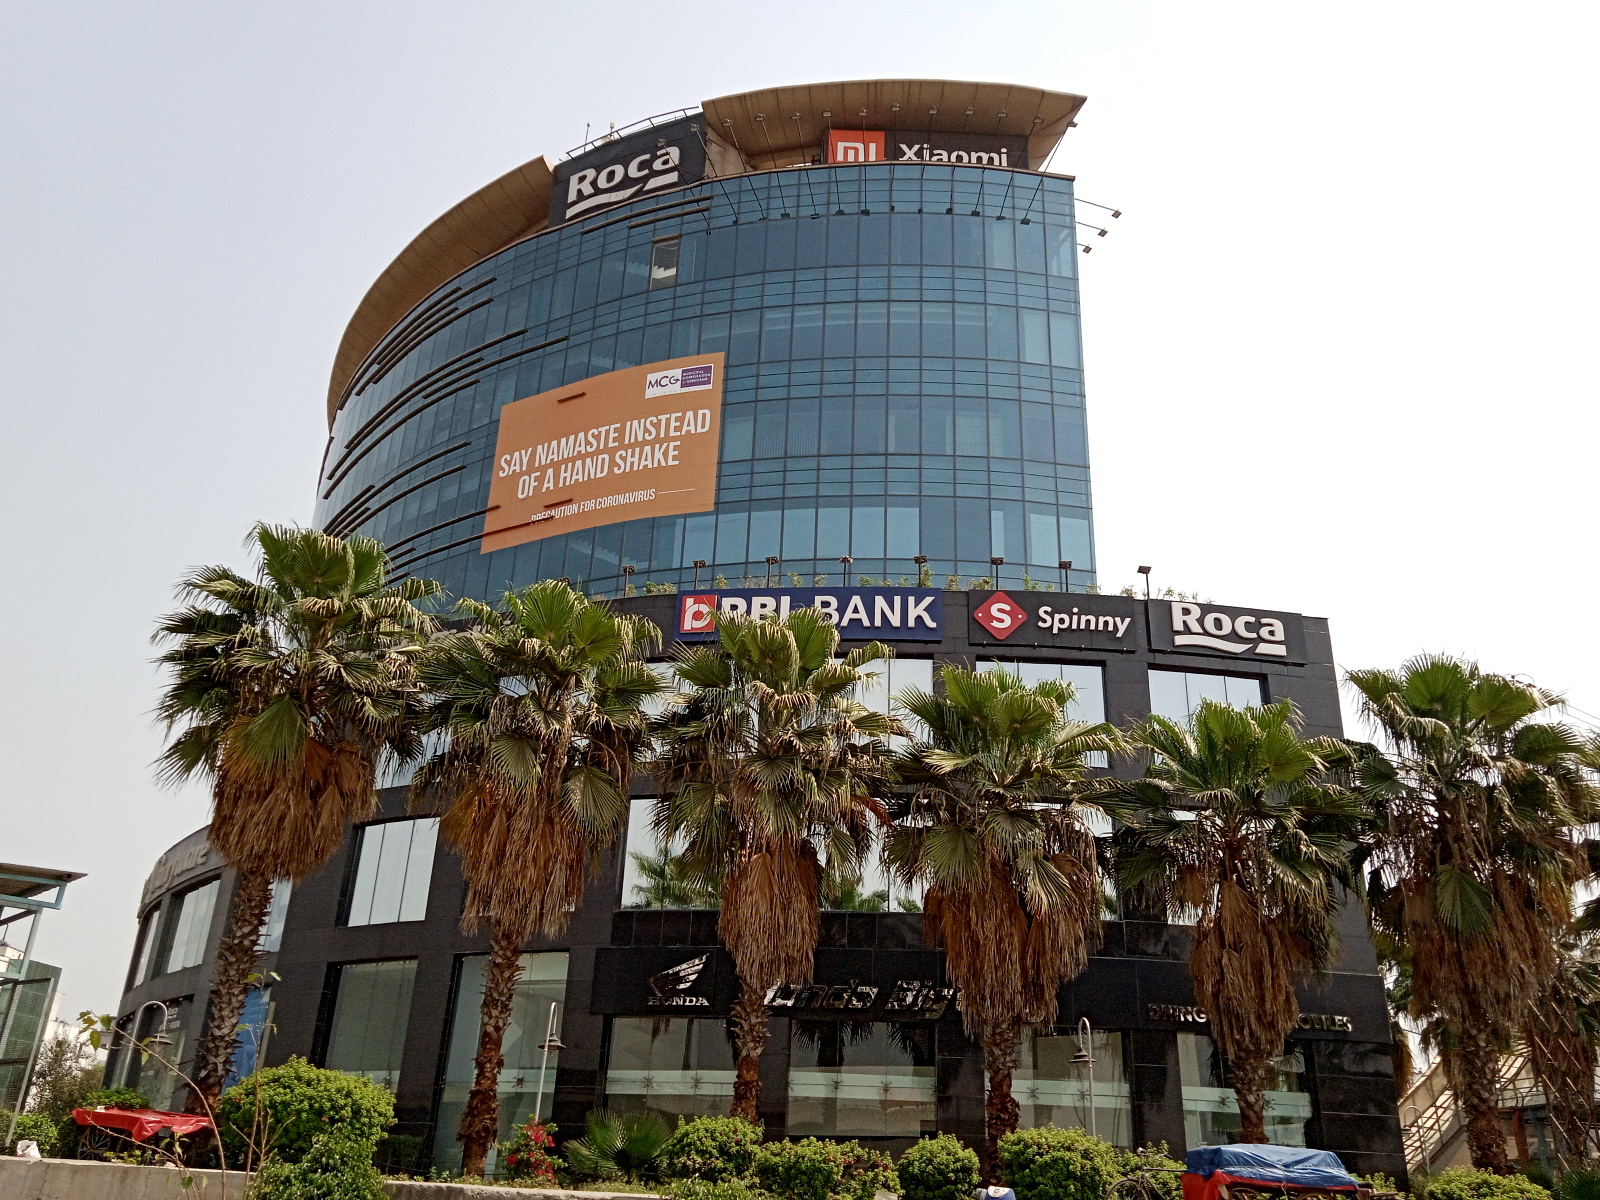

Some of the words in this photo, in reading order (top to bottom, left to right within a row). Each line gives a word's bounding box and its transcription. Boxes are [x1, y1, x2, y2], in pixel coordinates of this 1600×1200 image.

[899, 143, 1008, 167] Xiaomi
[566, 143, 681, 205] Roca
[647, 375, 680, 389] MCG
[499, 447, 532, 478] SAY
[534, 423, 620, 468] NAMASTE
[624, 409, 711, 444] INSTEAD
[517, 471, 540, 499] OF
[541, 468, 554, 493] A
[558, 453, 609, 488] HAND
[614, 441, 681, 474] SHAKE
[580, 500, 595, 512] FOR
[596, 488, 656, 509] CORONAVIRUS
[814, 595, 937, 629] BANK
[1038, 606, 1131, 638] Spinny
[1171, 602, 1285, 641] Roca
[648, 997, 709, 1006] HONDA
